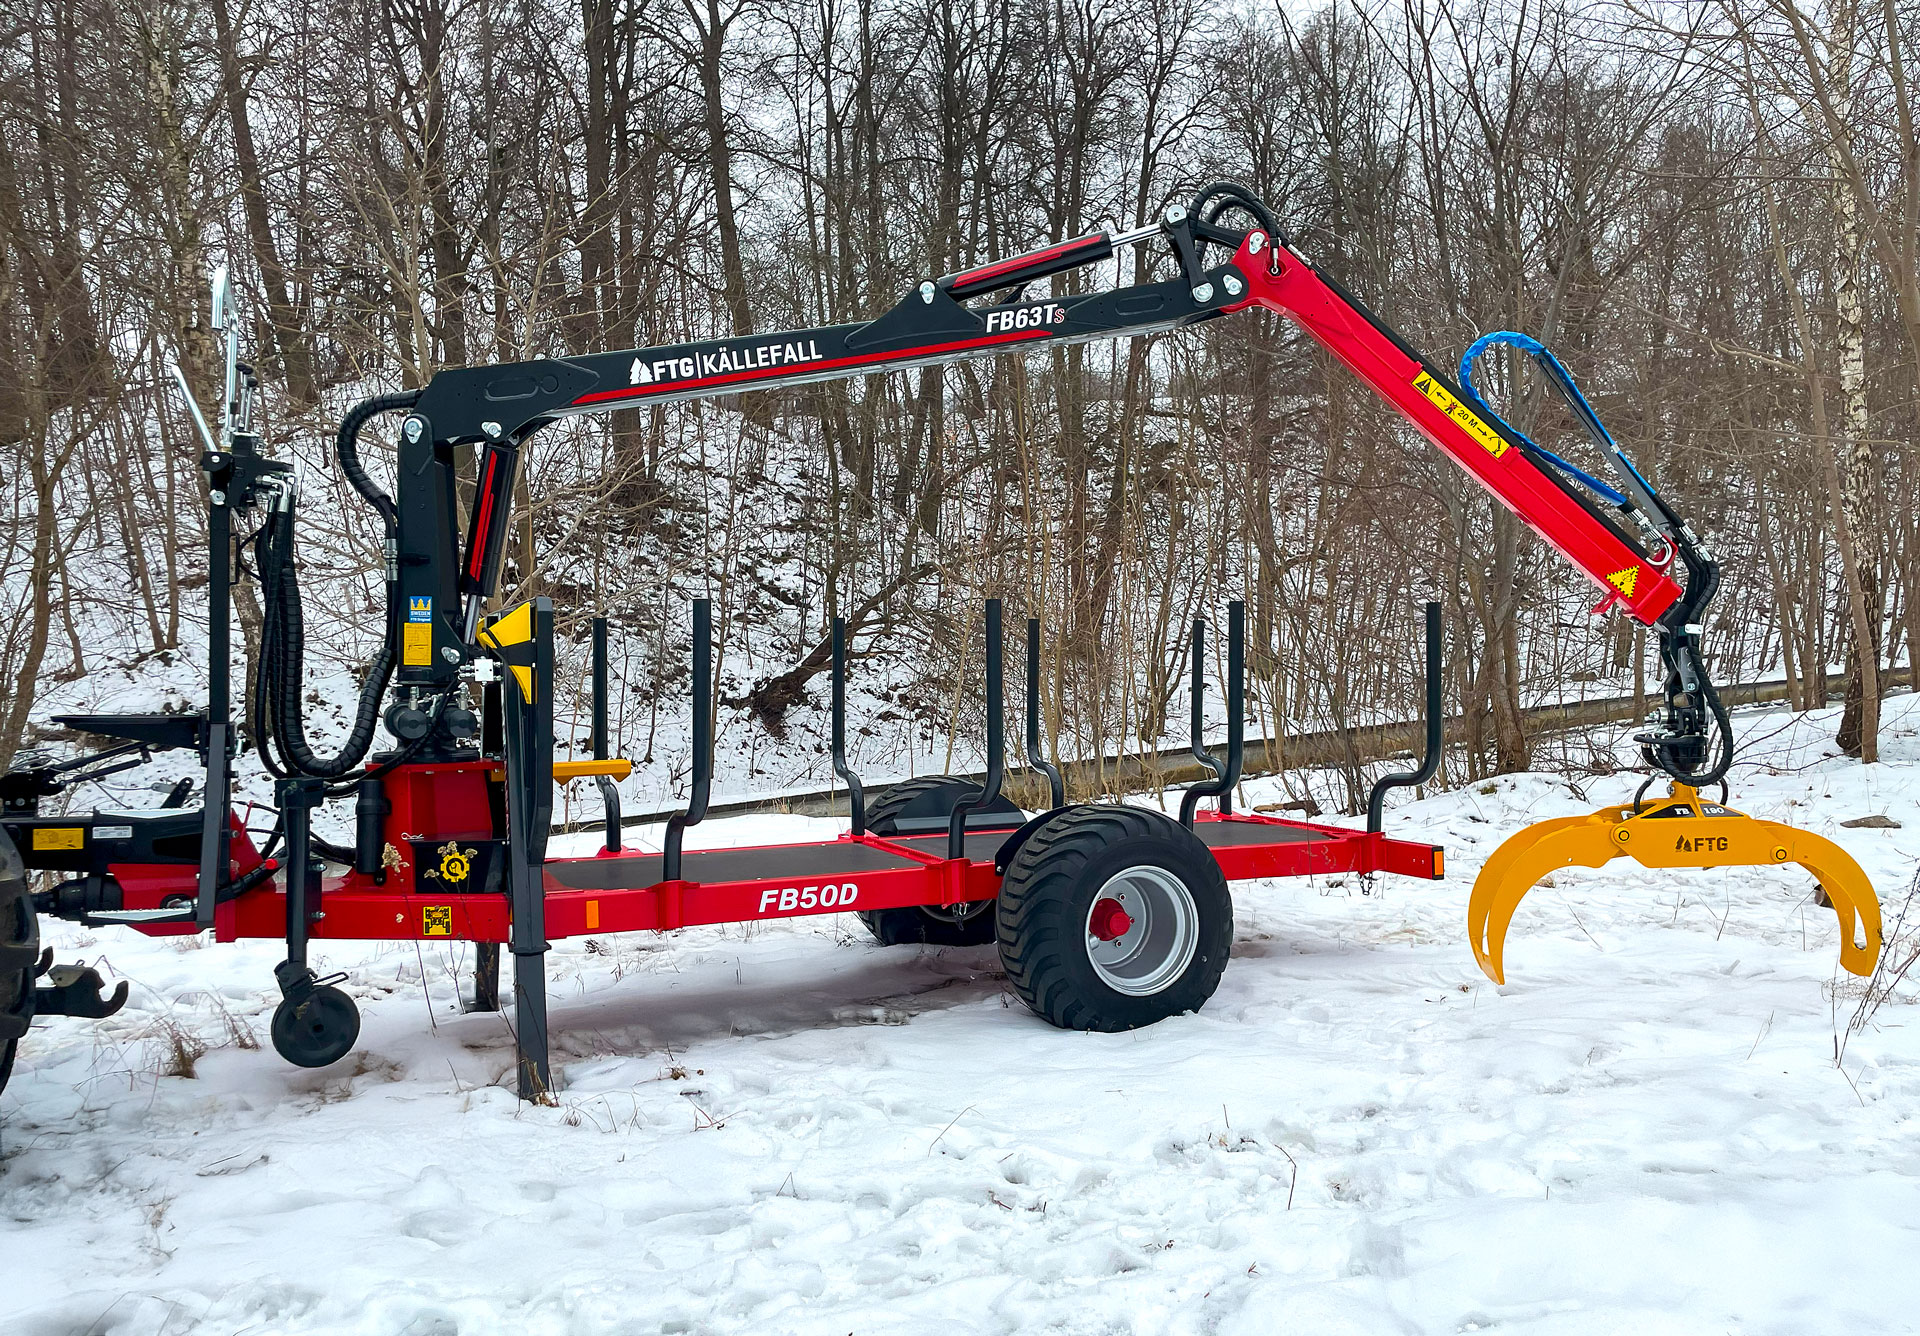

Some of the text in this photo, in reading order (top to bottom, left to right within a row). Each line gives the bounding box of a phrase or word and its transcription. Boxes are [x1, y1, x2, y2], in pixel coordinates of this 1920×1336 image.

[1457, 409, 1478, 428] 20 M
[1694, 837, 1728, 851] FTG
[758, 883, 858, 913] FB50D
